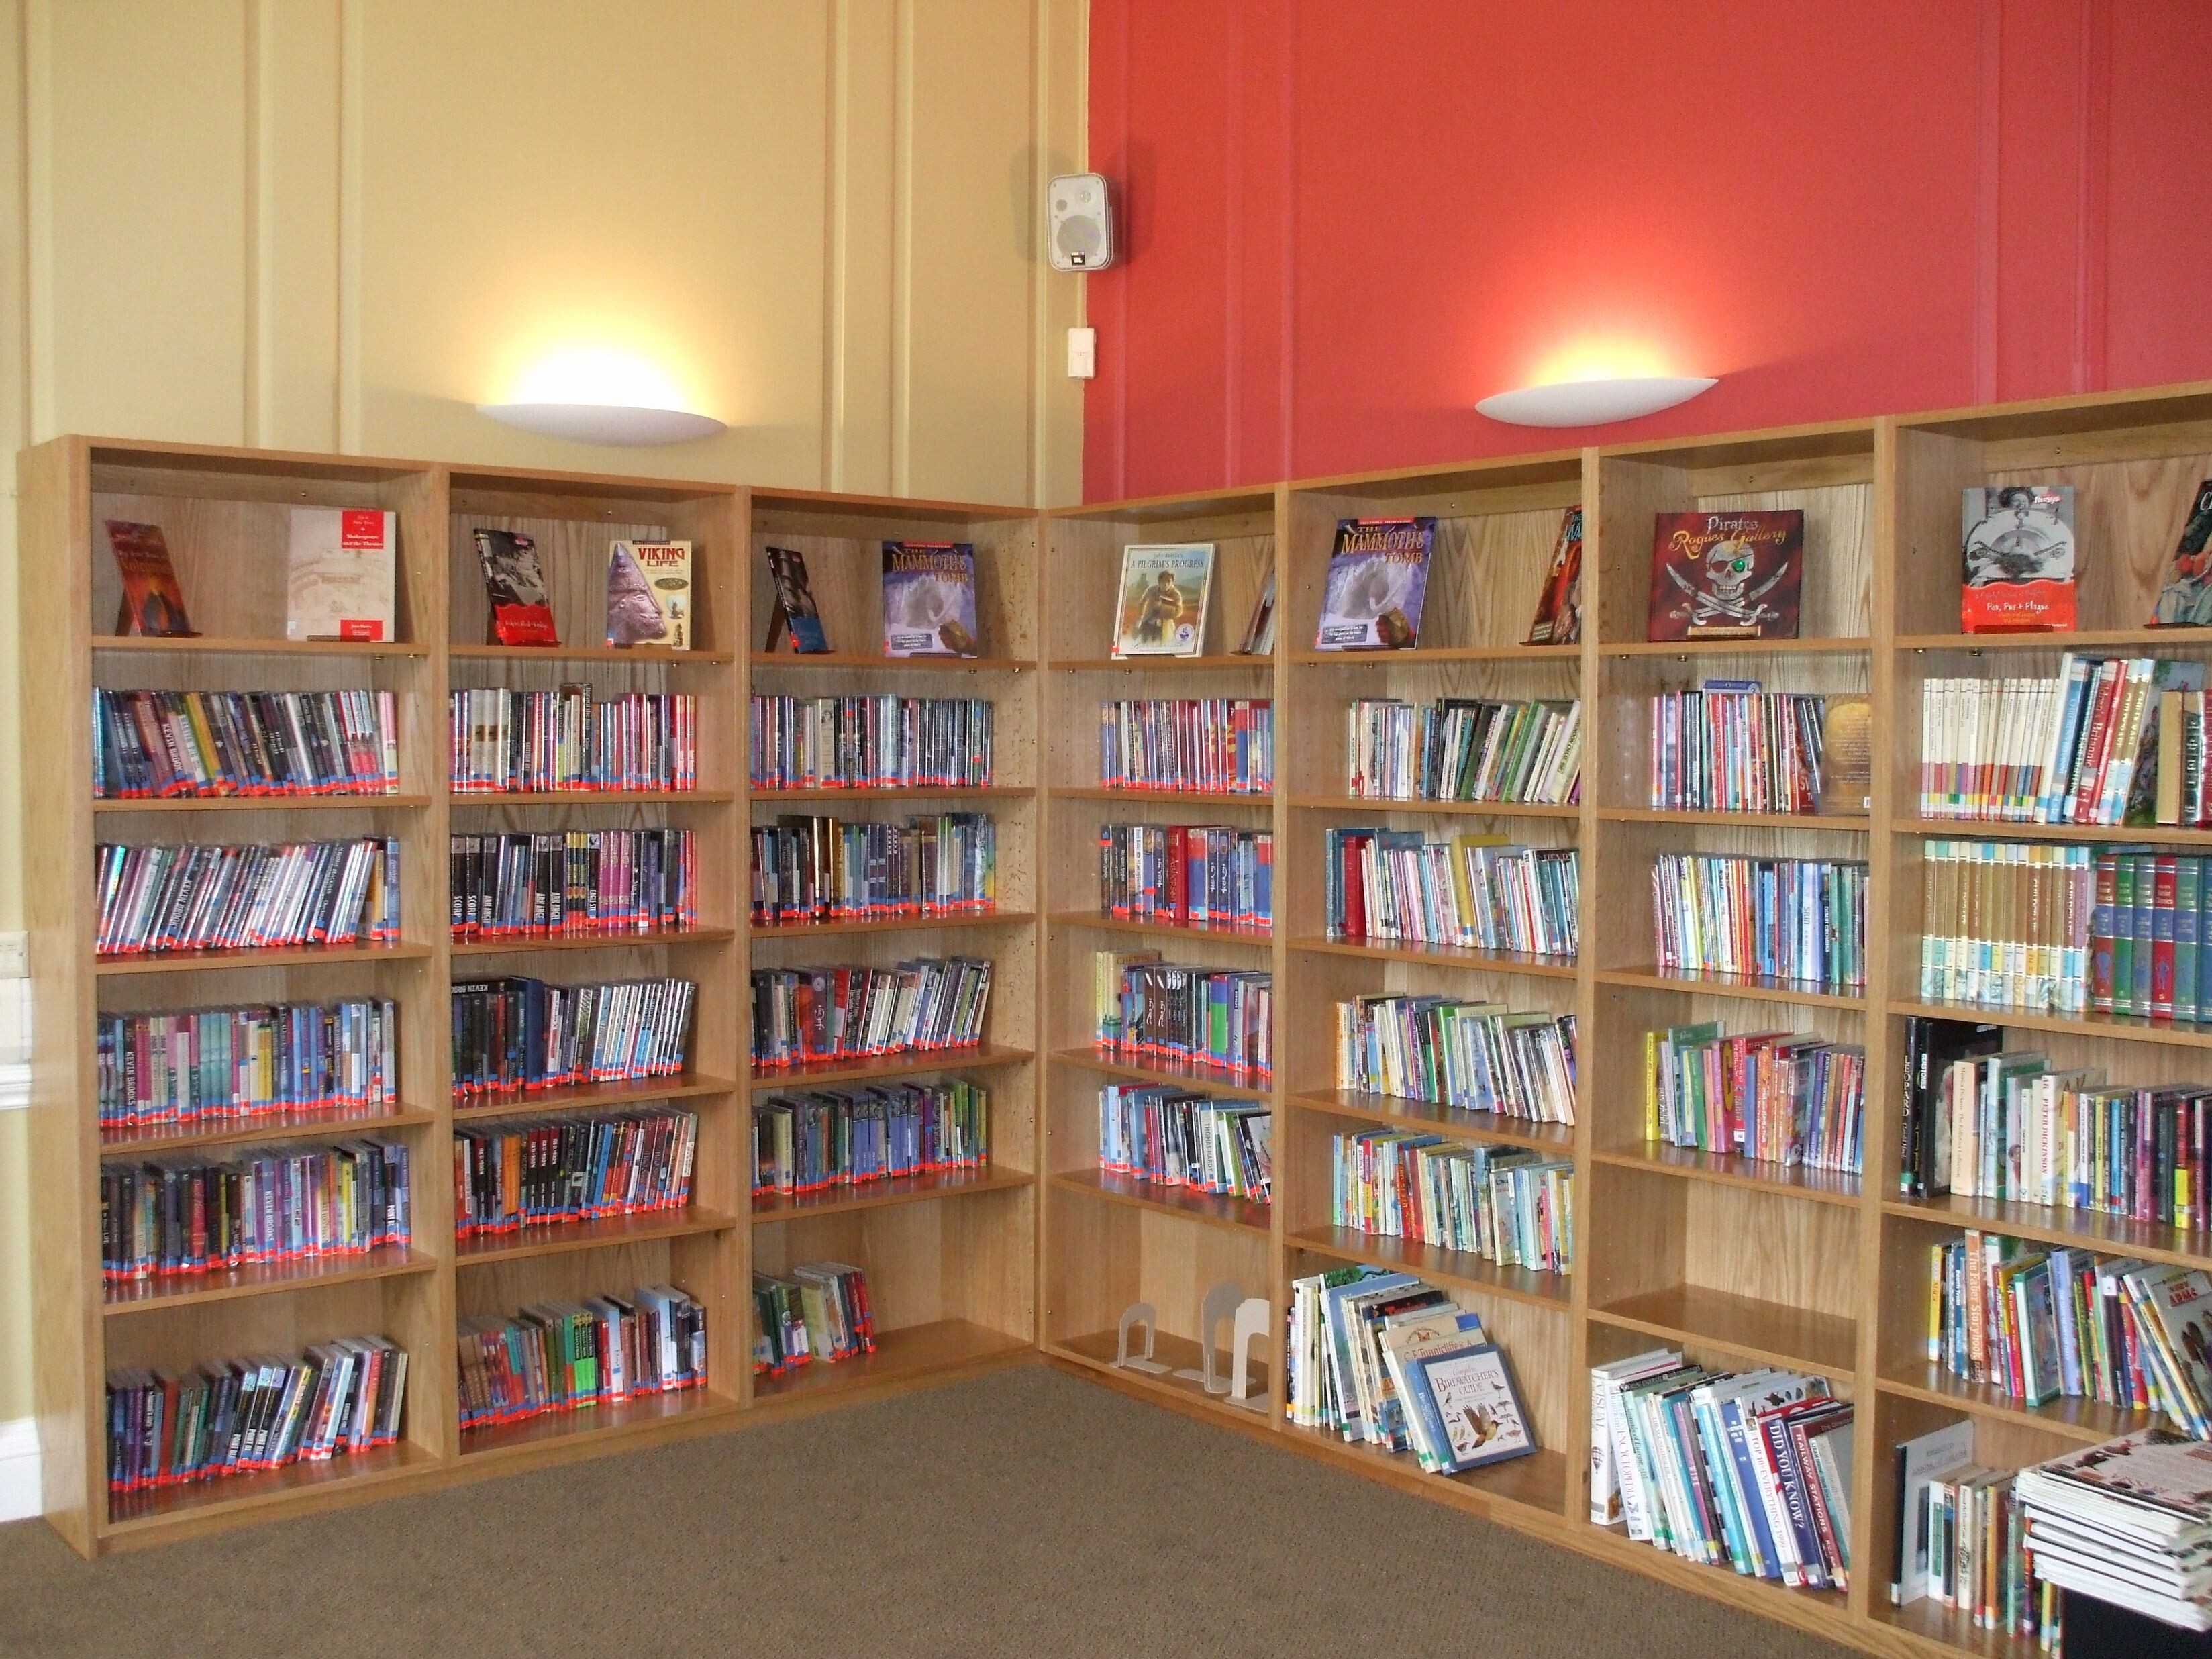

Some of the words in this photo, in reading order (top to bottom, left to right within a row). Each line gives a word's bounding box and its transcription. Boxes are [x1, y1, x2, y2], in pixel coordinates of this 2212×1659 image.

[1707, 516, 1758, 534] Pirates
[638, 548, 685, 560] VIKING
[1668, 530, 1723, 560] Rogues
[1731, 527, 1788, 551] Gallery
[1138, 560, 1170, 568] PILGRIM'S
[1171, 559, 1205, 568] PROGRESS
[1385, 552, 1423, 564] TOMB
[126, 1051, 136, 1074] KEVIN
[126, 1077, 136, 1105] BROOKS
[1204, 1123, 1213, 1149] THOMAS
[2041, 1127, 2049, 1174] DICKINSON
[266, 1191, 274, 1213] KEVIN
[1968, 1250, 1980, 1270] The
[1969, 1272, 1980, 1301] Faber
[1969, 1303, 1983, 1360] Storybook
[1434, 1369, 1499, 1392] BIRDWATCHER'S
[1458, 1383, 1485, 1395] GUIDE
[1595, 1383, 1605, 1430] VISUAL
[1617, 1429, 1636, 1500] ENCYCLOPEDIA
[1770, 1425, 1782, 1447] DID
[1776, 1453, 1791, 1480] YOU
[1784, 1483, 1805, 1528] KNOW?
[1752, 1436, 1761, 1453] TOP
[1760, 1470, 1779, 1525] EVERYTHING
[1776, 1529, 1786, 1548] 1999
[1796, 1434, 1813, 1479] RAILWAY
[1809, 1483, 1827, 1533] STATIONS
